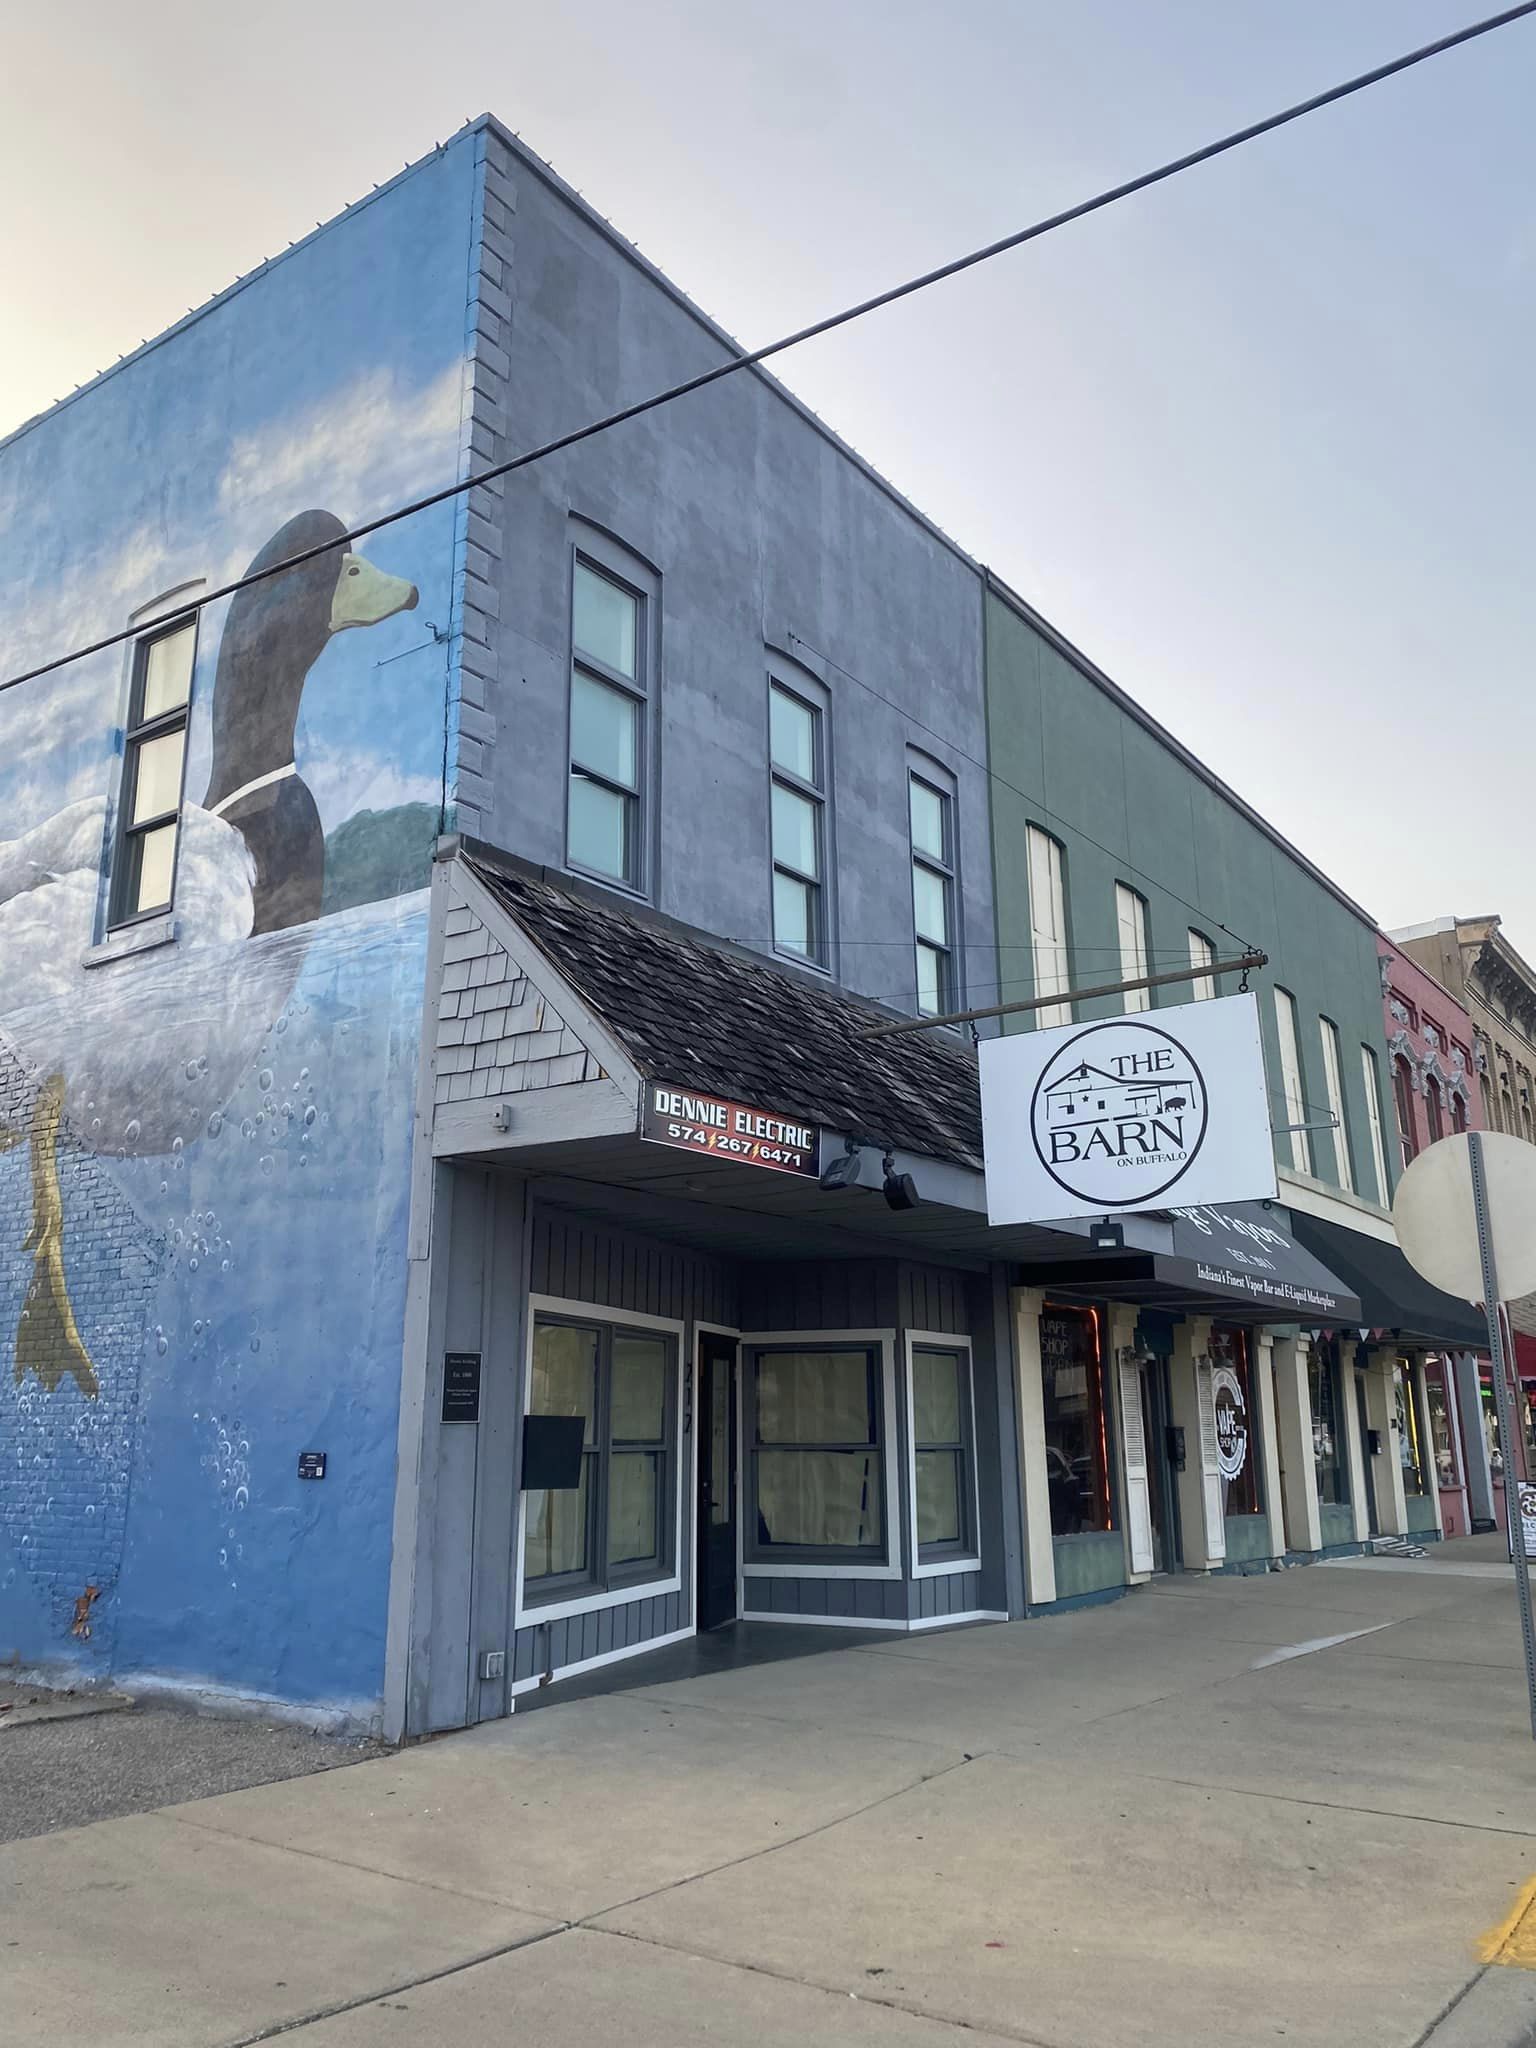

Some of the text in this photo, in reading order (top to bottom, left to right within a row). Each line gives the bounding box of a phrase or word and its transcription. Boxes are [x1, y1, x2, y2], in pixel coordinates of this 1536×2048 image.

[1111, 1049, 1174, 1076] THE
[654, 1089, 812, 1150] DENNIE ELECTRIC
[1049, 1116, 1184, 1165] BARN
[667, 1123, 801, 1167] 574 267 6471
[1117, 1151, 1188, 1168] ON BUFFALO
[1197, 1263, 1337, 1312] Indiana's Finest Vapor Bar and E-Liquid Marketplace
[1041, 1336, 1069, 1356] SHOP
